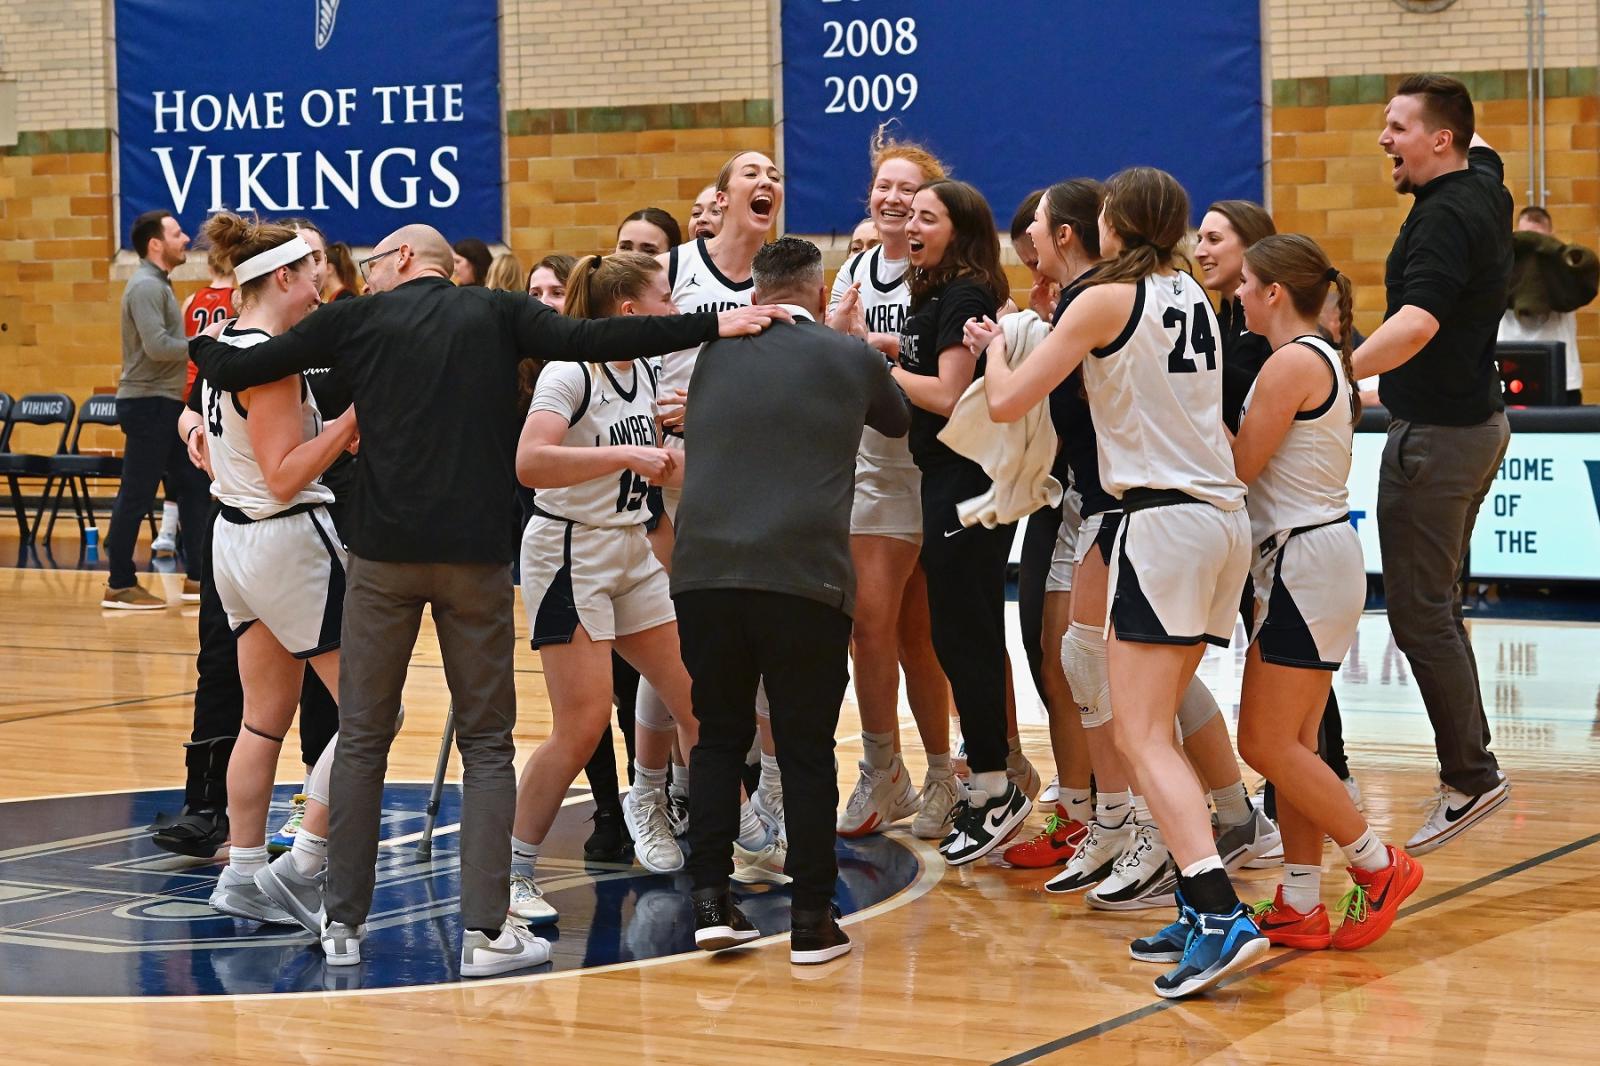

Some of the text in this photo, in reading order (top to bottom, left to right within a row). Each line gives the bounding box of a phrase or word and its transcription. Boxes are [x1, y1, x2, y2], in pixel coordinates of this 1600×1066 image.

[823, 17, 918, 58] 2008
[152, 83, 465, 133] HOME OF THE
[825, 73, 919, 113] 2009
[151, 145, 461, 214] VIKINGS
[1162, 302, 1217, 373] 24
[21, 401, 64, 415] VIKINGS
[1494, 494, 1522, 517] OF
[1494, 530, 1538, 553] THE
